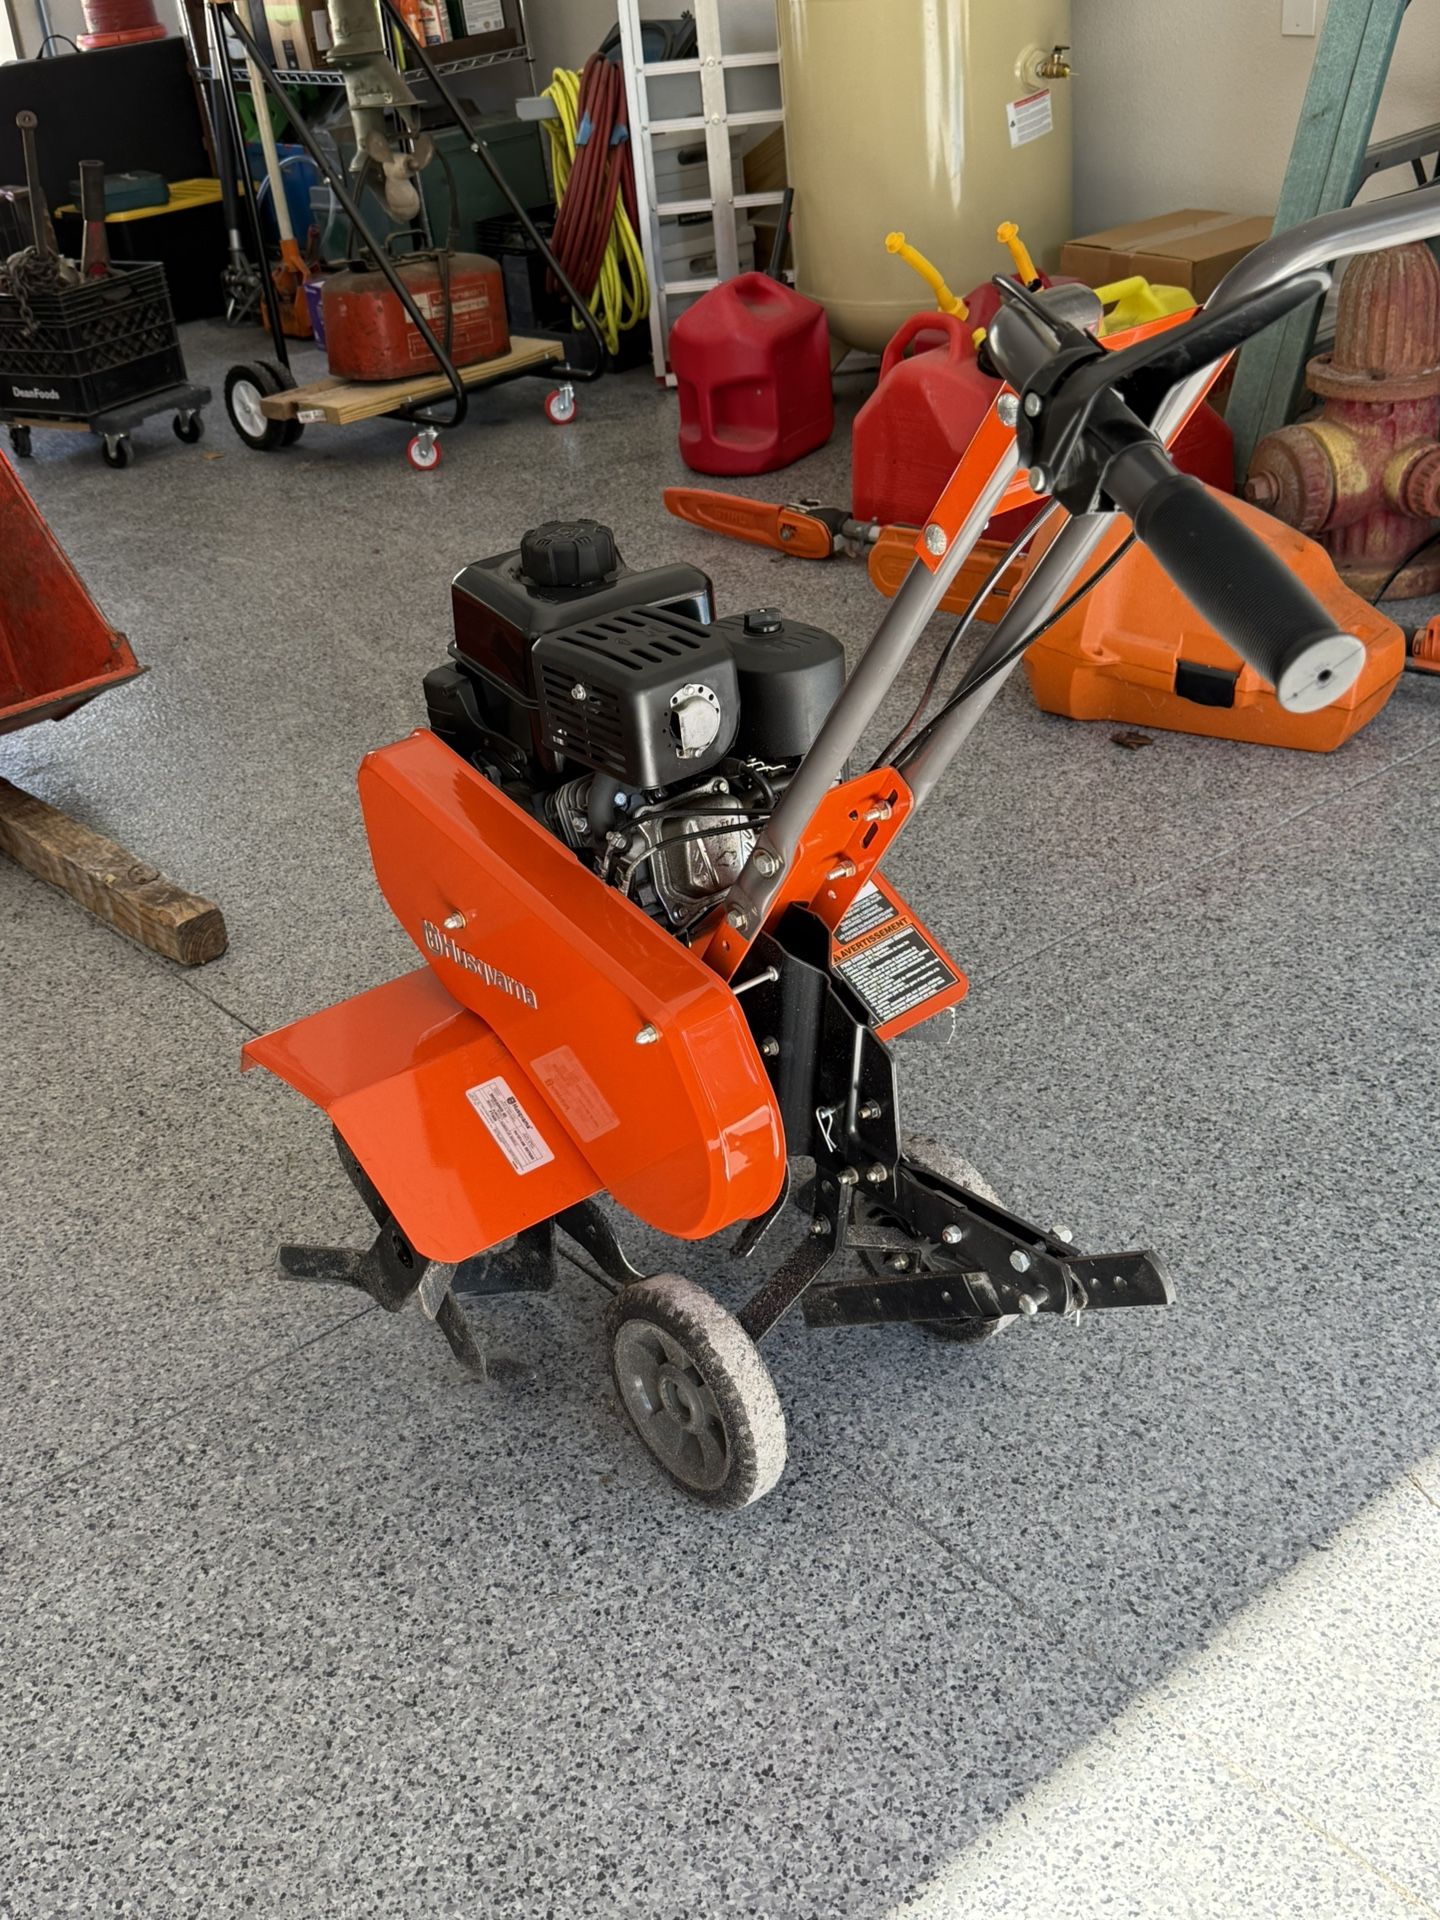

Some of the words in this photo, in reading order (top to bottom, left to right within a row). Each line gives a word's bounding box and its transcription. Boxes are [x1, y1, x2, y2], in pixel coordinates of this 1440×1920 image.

[12, 386, 60, 400] DeanFoods
[841, 917, 910, 957] AVERTISSEMENT
[441, 933, 538, 1010] Husqvarna
